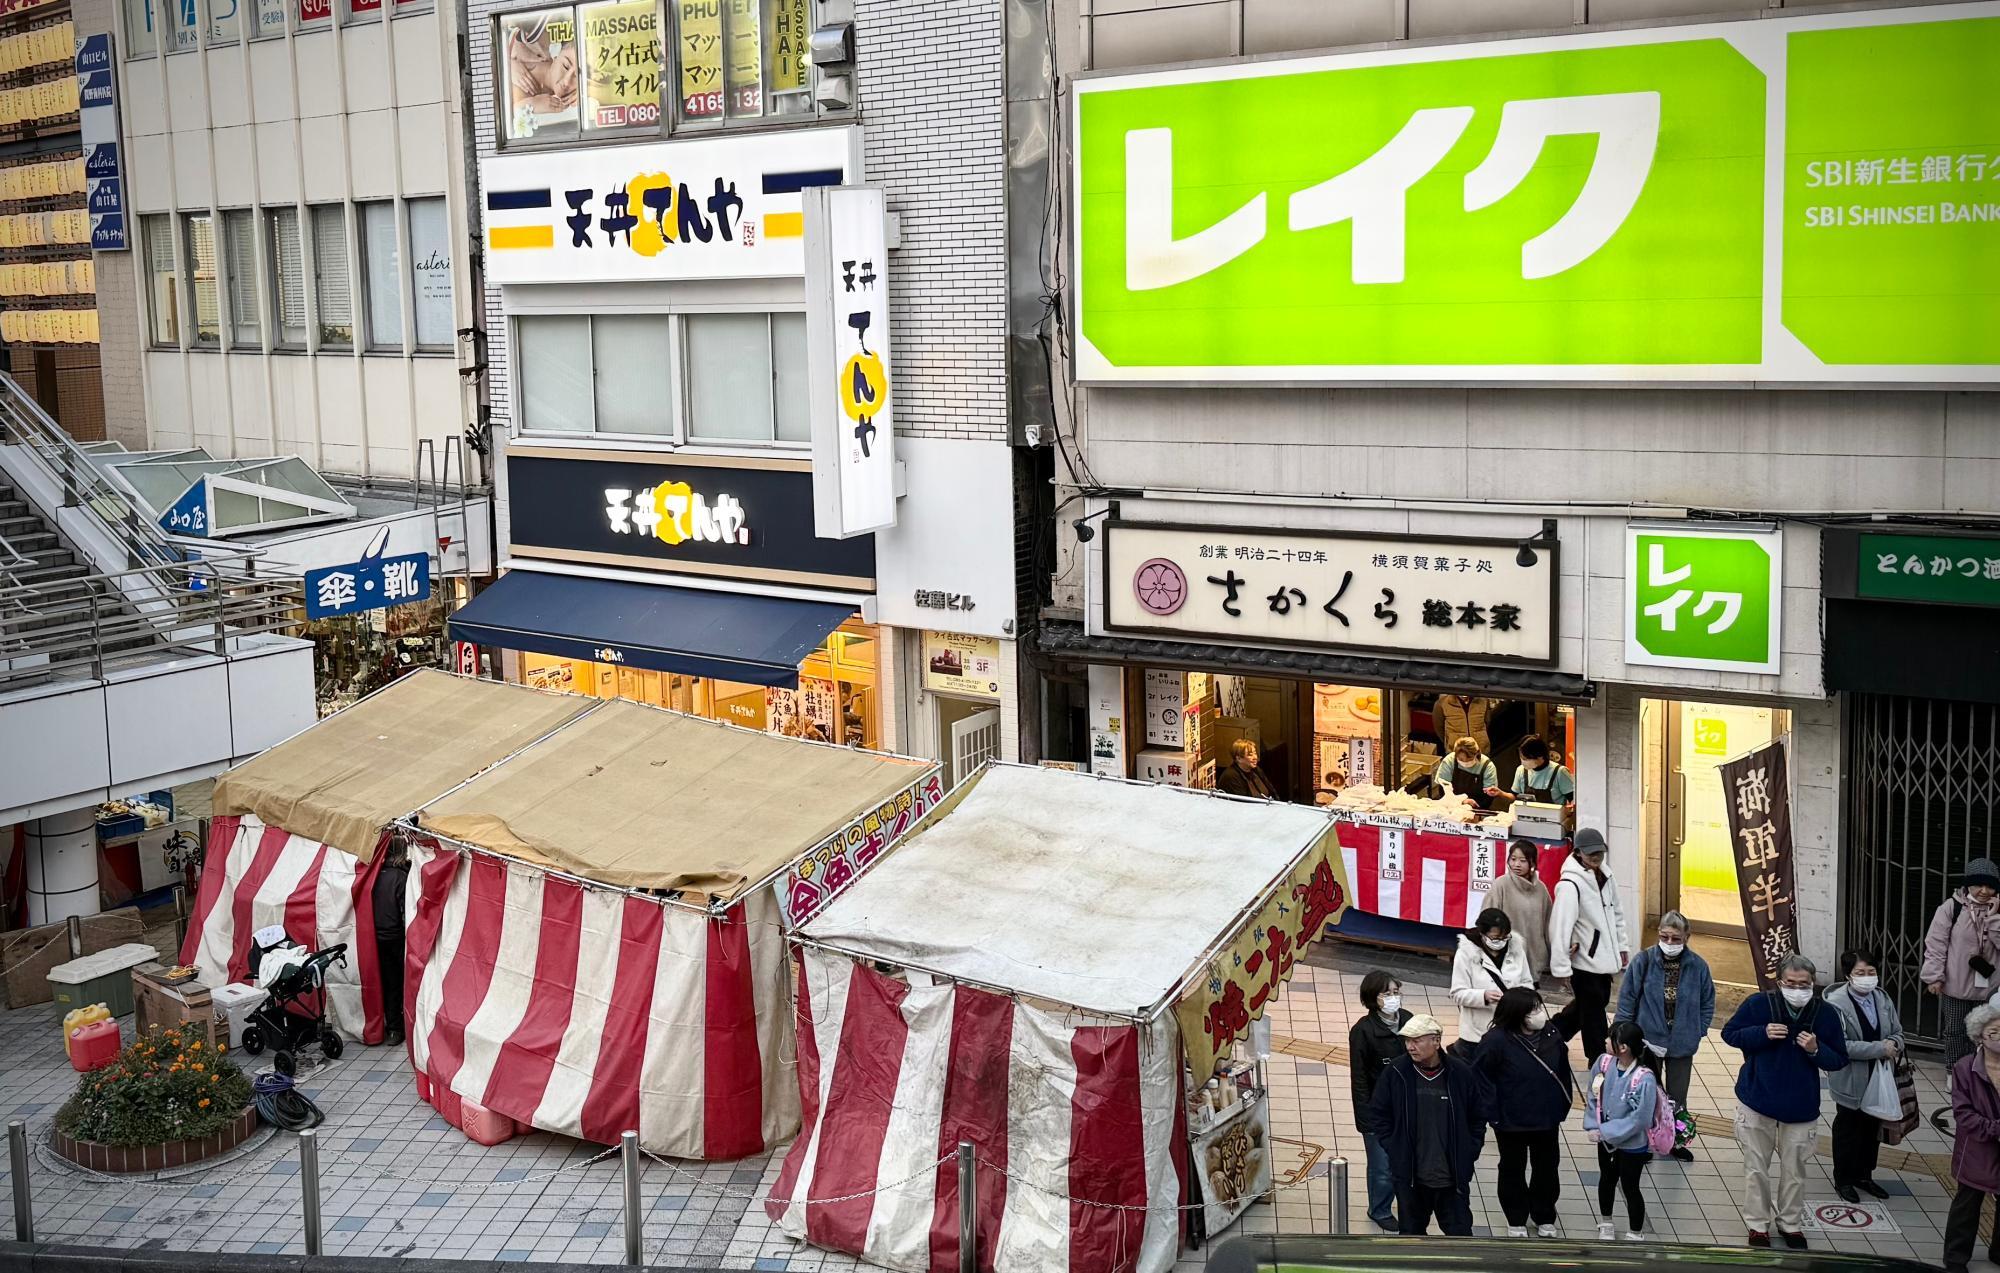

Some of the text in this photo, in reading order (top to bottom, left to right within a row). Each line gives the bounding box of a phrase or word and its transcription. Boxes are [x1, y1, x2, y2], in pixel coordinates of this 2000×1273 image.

[586, 13, 657, 37] MASSAGE
[599, 40, 658, 67] タイ古式
[615, 73, 658, 97] オイル
[600, 107, 623, 124] TEL
[1125, 91, 1661, 291] レイク
[565, 177, 744, 249] 天丼てんや
[1805, 206, 1844, 227] SBI
[1848, 205, 1935, 227] SHINSEI
[842, 258, 877, 293] 天丼
[848, 311, 877, 458] てんや
[170, 505, 205, 530] 山口屋
[604, 486, 746, 544] 天丼てんや
[1199, 544, 1493, 573] 創業 明治二十四年 横須賀菓子処
[317, 559, 419, 610] 傘・靴
[1207, 569, 1521, 631] さかくら 総本家
[976, 661, 989, 672] 3F
[1160, 694, 1179, 702] レイク
[1357, 740, 1365, 771] きんつば
[1476, 843, 1489, 878] お赤飯
